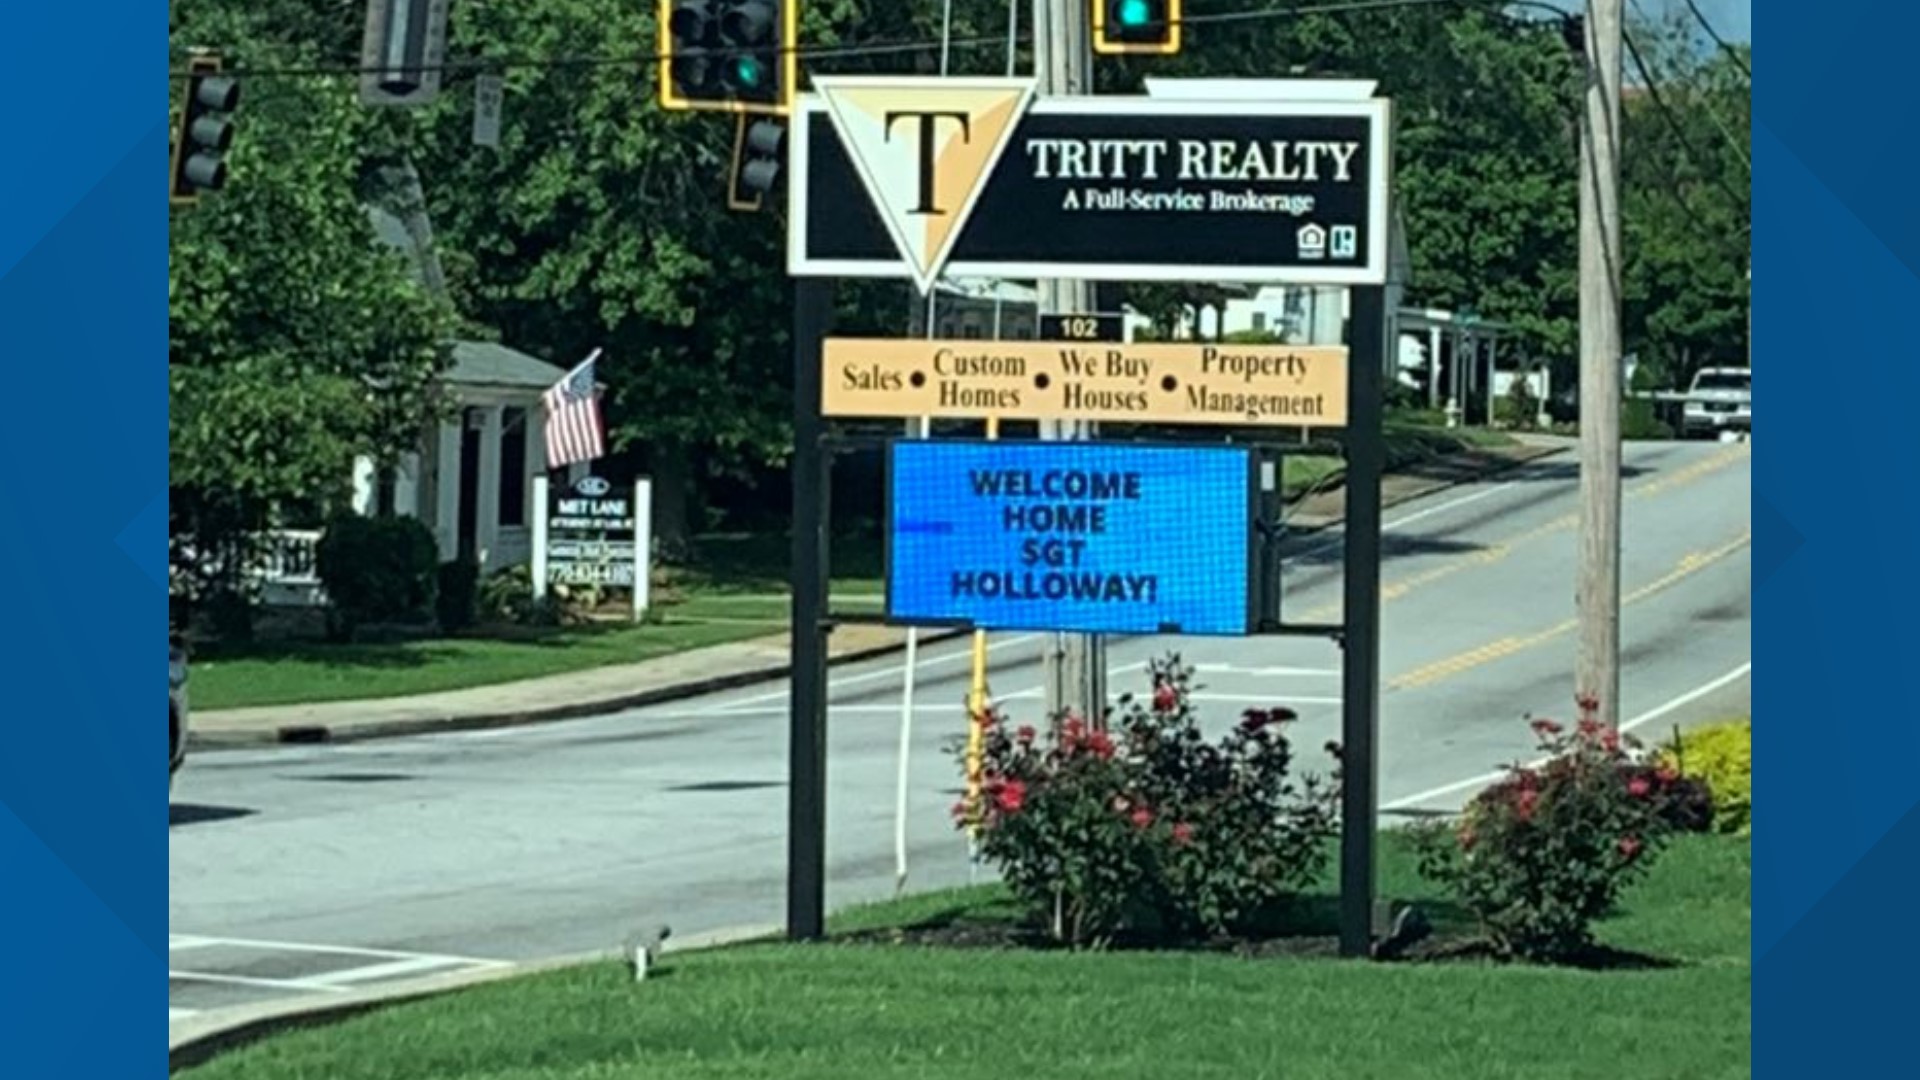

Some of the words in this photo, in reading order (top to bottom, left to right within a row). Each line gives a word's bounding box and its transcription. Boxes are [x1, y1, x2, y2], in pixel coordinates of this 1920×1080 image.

[884, 111, 970, 216] T
[1026, 139, 1167, 179] TRITT
[1178, 140, 1360, 181] REALTY
[1062, 188, 1080, 210] A
[1084, 188, 1204, 211] Full-Service
[1210, 189, 1315, 216] Brokerage
[1060, 318, 1098, 337] 102
[842, 363, 903, 390] Sales
[933, 348, 1026, 376] Custom
[1059, 350, 1098, 377] We
[1106, 350, 1153, 384] Buy
[1201, 347, 1309, 383] Property
[939, 381, 1021, 408] Homes
[1063, 383, 1149, 410] Houses
[1187, 384, 1324, 418] Management
[968, 469, 1142, 500] WELCOME
[1003, 505, 1106, 534] HOME
[1020, 538, 1087, 567] SGT
[951, 570, 1157, 603] HOLLOWAY!
